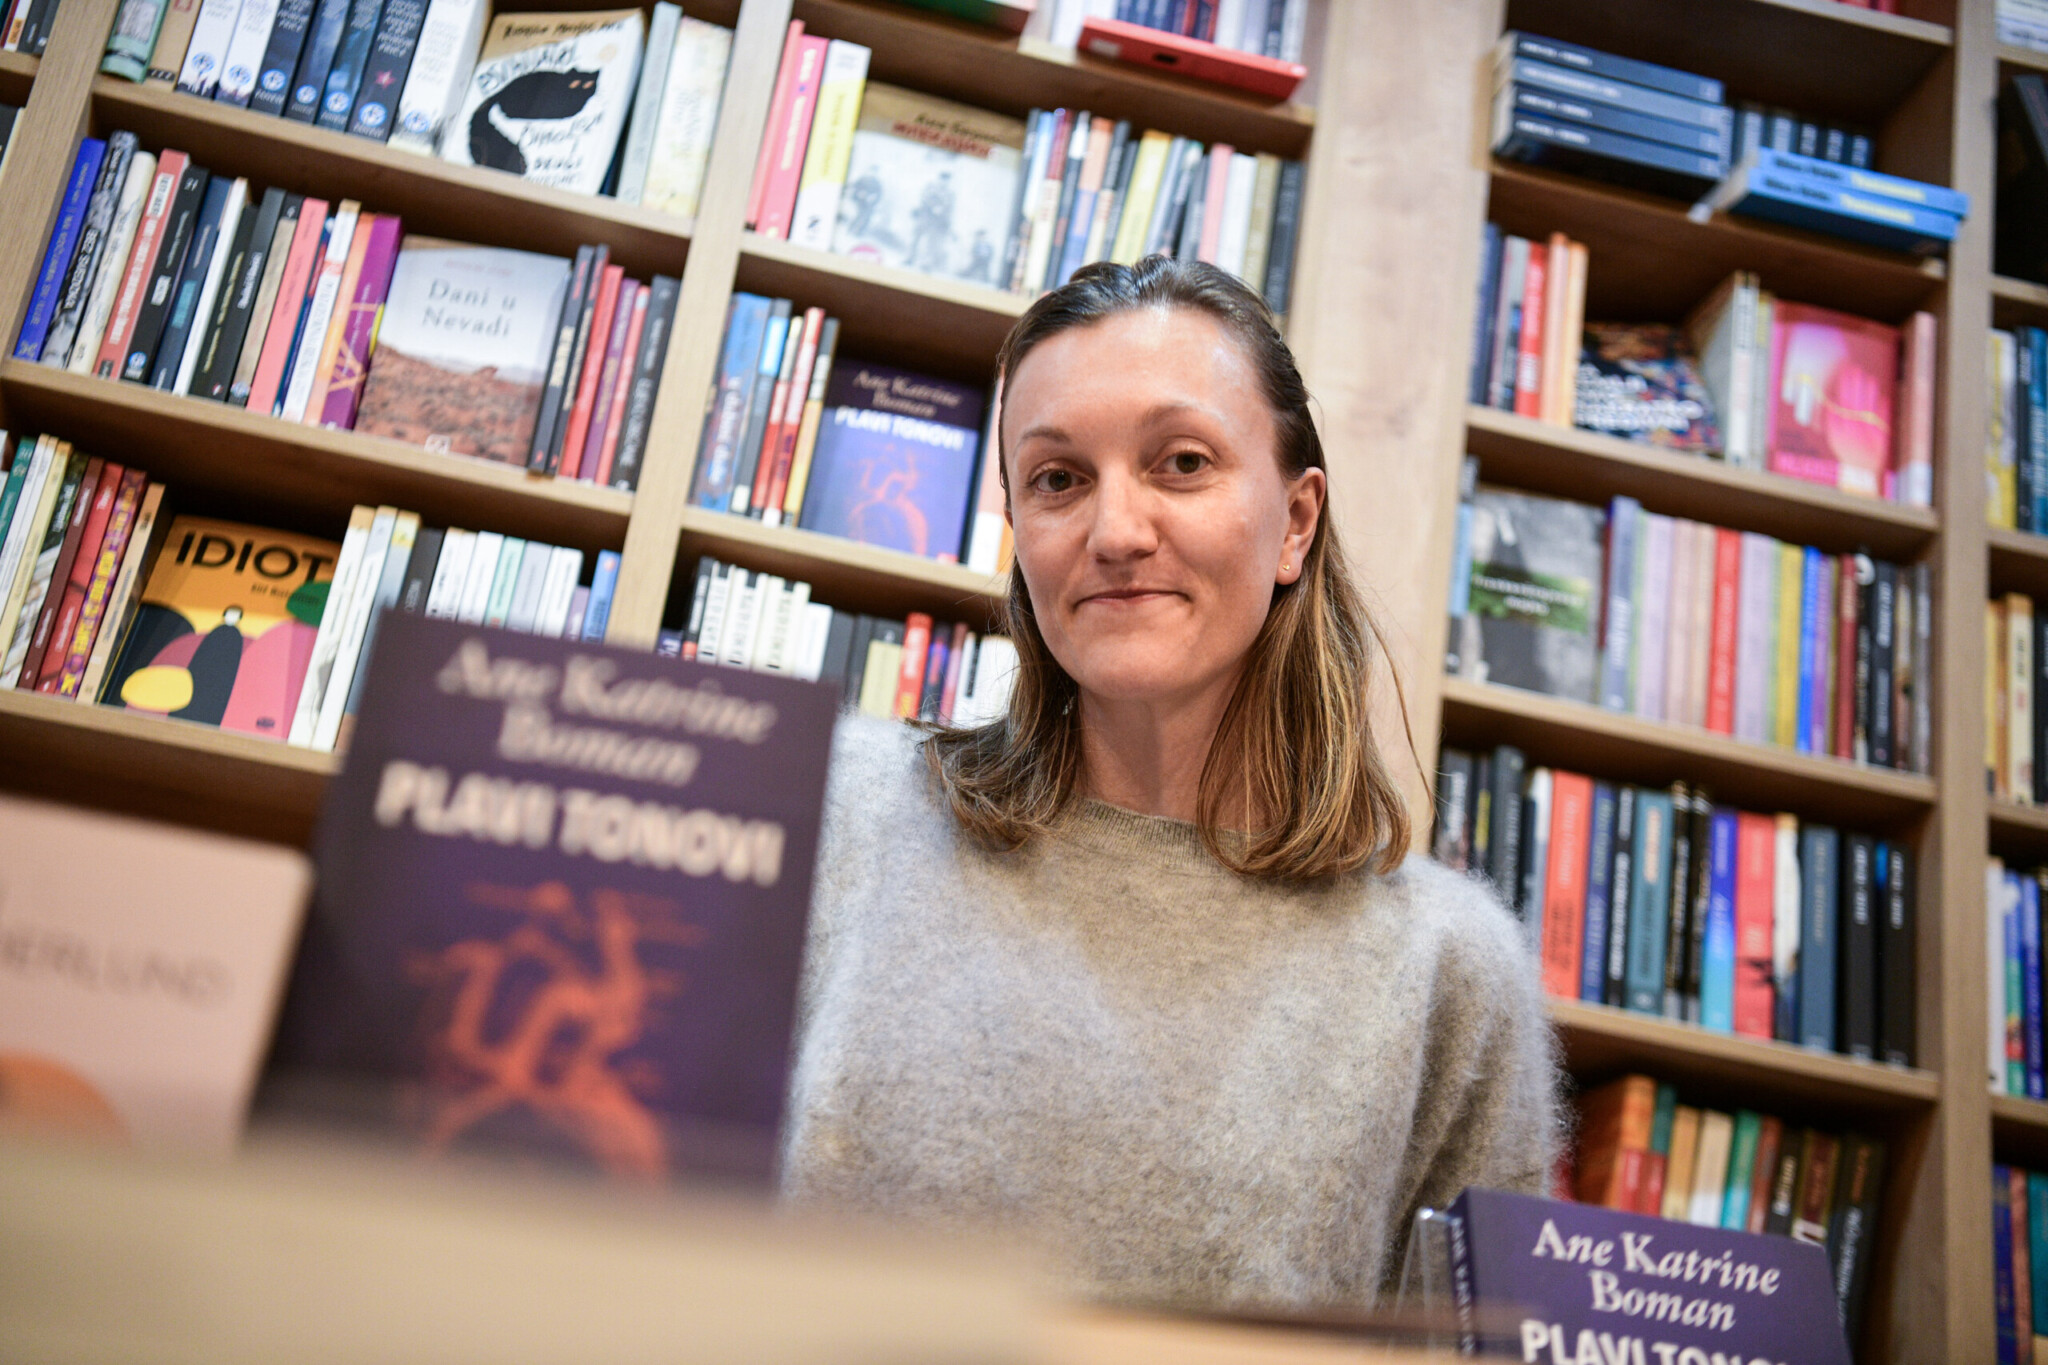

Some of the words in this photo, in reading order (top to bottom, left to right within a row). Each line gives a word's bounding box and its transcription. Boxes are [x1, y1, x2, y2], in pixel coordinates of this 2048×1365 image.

[428, 277, 491, 309] Dani
[501, 295, 517, 310] u
[421, 306, 511, 338] Nevadi
[835, 405, 892, 434] PLAVI
[893, 416, 965, 450] TONOVI
[174, 531, 333, 582] IDIOT
[438, 638, 559, 697] Ane
[560, 655, 778, 744] Katrine
[498, 701, 700, 787] Boman
[375, 760, 557, 848] PLAVI
[559, 790, 786, 887] TONOVI
[1532, 1219, 1613, 1267] Ane
[1620, 1232, 1780, 1295] Katrine
[1589, 1270, 1736, 1331] Boman
[1520, 1319, 1646, 1365] PLAVI
